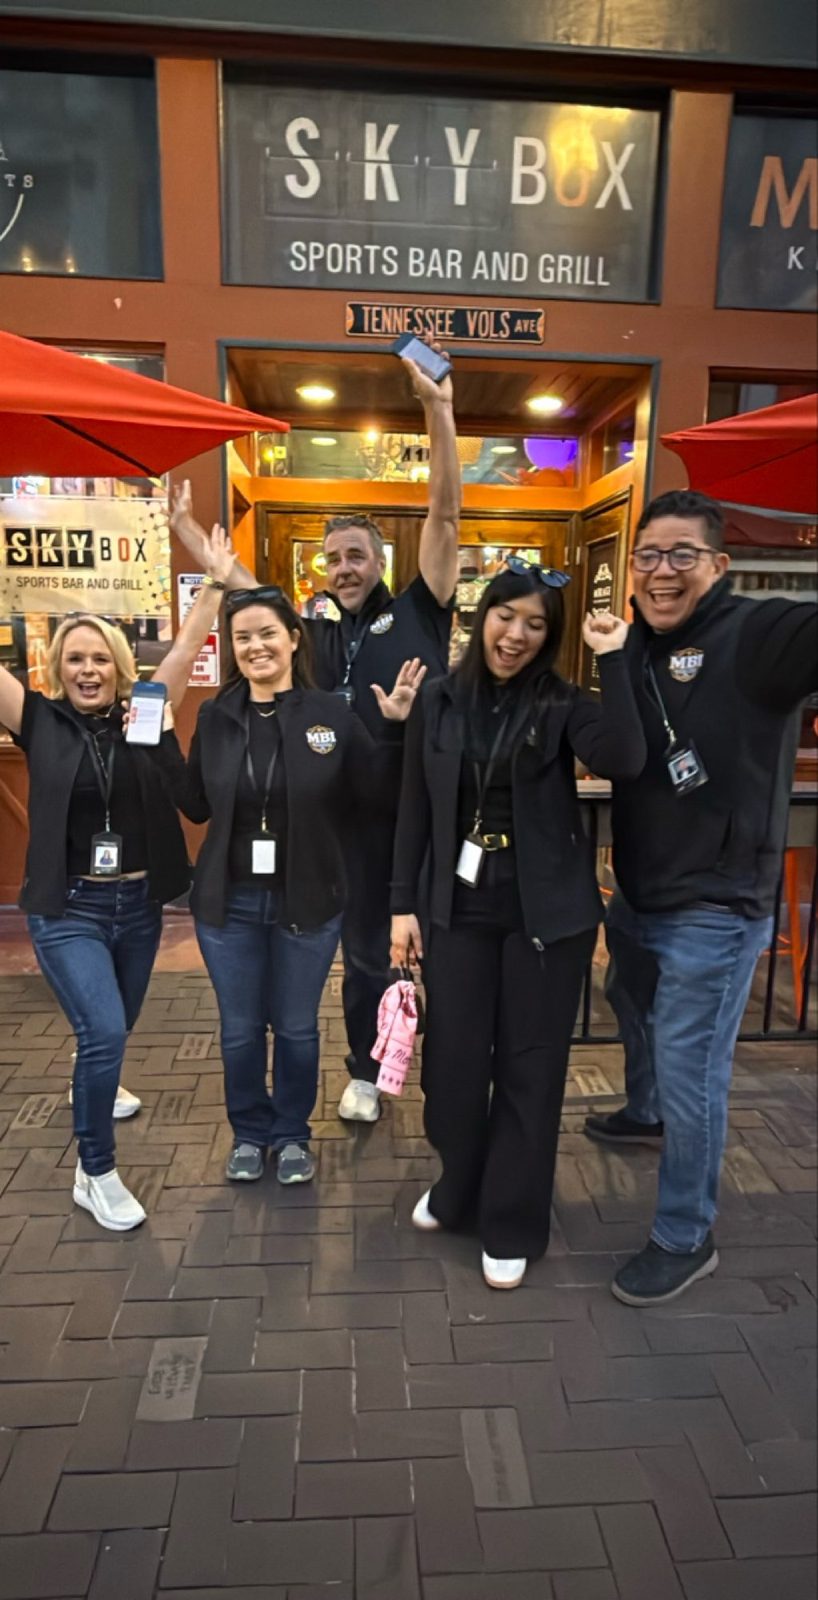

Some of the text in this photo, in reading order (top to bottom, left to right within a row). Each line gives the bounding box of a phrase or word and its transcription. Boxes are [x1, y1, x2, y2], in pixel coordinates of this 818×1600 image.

[284, 116, 636, 211] SKYBOX
[289, 241, 611, 287] SPORTS BAR AND GRILL
[362, 305, 537, 339] TENNESSEE VOLS AVE
[401, 447, 430, 462] 41
[11, 532, 147, 564] SKYBOX
[16, 575, 143, 591] SPORTS BAR AND GRILL
[668, 653, 705, 670] MBI
[305, 731, 337, 744] MBI
